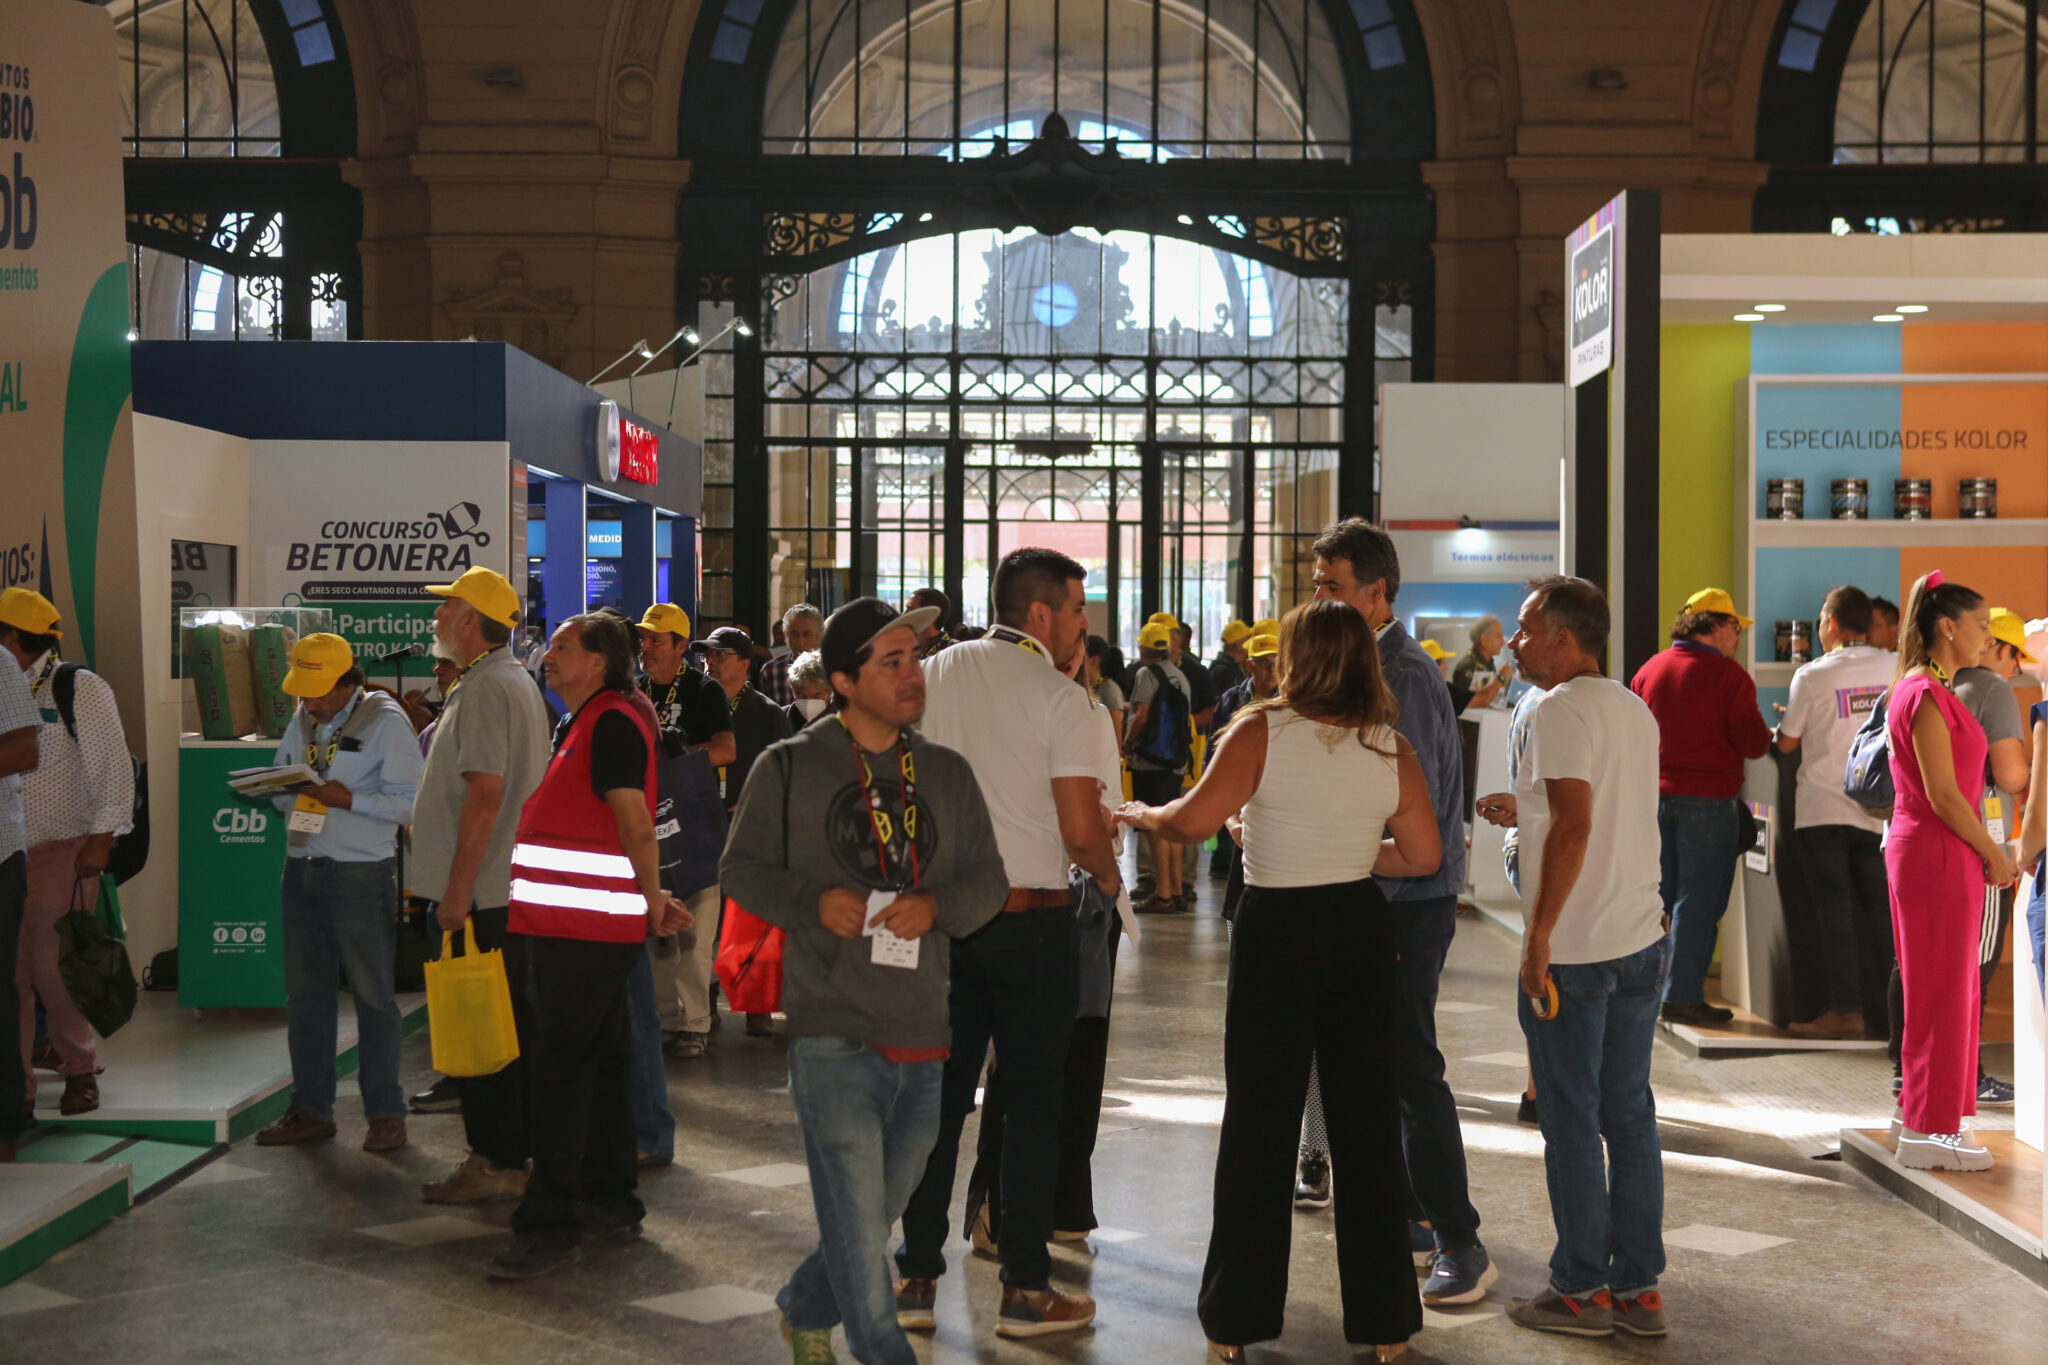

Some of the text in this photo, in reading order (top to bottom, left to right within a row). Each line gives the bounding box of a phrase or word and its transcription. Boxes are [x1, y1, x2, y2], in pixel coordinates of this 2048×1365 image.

[0, 63, 30, 90] TOS
[1575, 267, 1608, 323] KOLOR
[1577, 340, 1605, 368] PINTURAS
[1766, 429, 2028, 449] ESPECIALIDADES KOLOR
[321, 521, 438, 539] CONCURSO
[589, 535, 622, 543] MEDID
[0, 543, 35, 590] IOS:
[286, 543, 472, 571] BETONERA
[1451, 552, 1554, 562] Termos eléctricos
[307, 586, 433, 595] ¿ERES SECO CANTANDO EN LA CO
[333, 613, 435, 639] ¡Participa
[349, 642, 387, 657] TRO
[1852, 698, 1876, 710] KOLO
[213, 808, 267, 833] Cbb
[220, 834, 266, 843] Cementos
